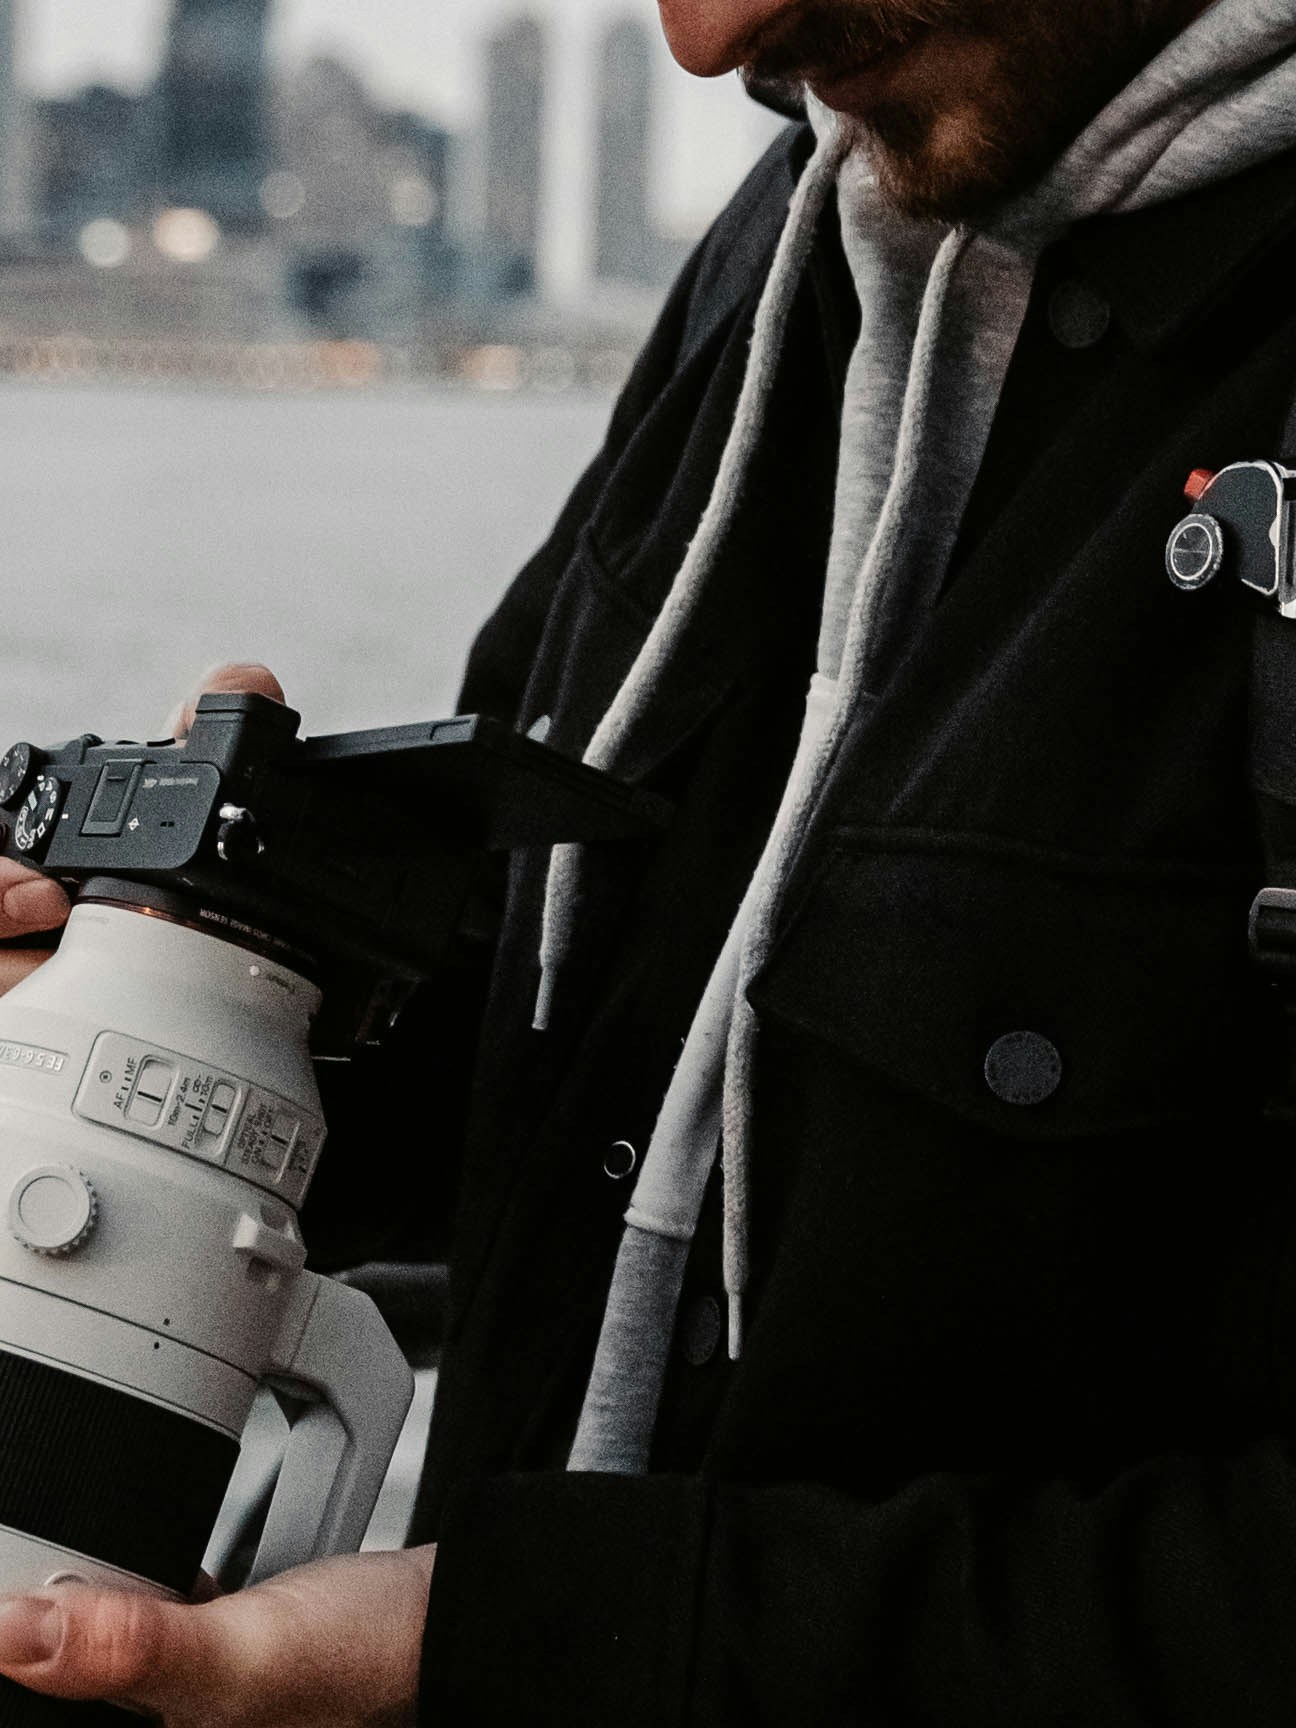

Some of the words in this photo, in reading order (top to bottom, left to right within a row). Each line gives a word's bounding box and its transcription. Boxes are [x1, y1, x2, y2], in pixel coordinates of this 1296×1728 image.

[46, 1055, 65, 1072] FE
[114, 1092, 125, 1110] AF
[125, 1057, 136, 1075] MF
[181, 1122, 199, 1150] FULL
